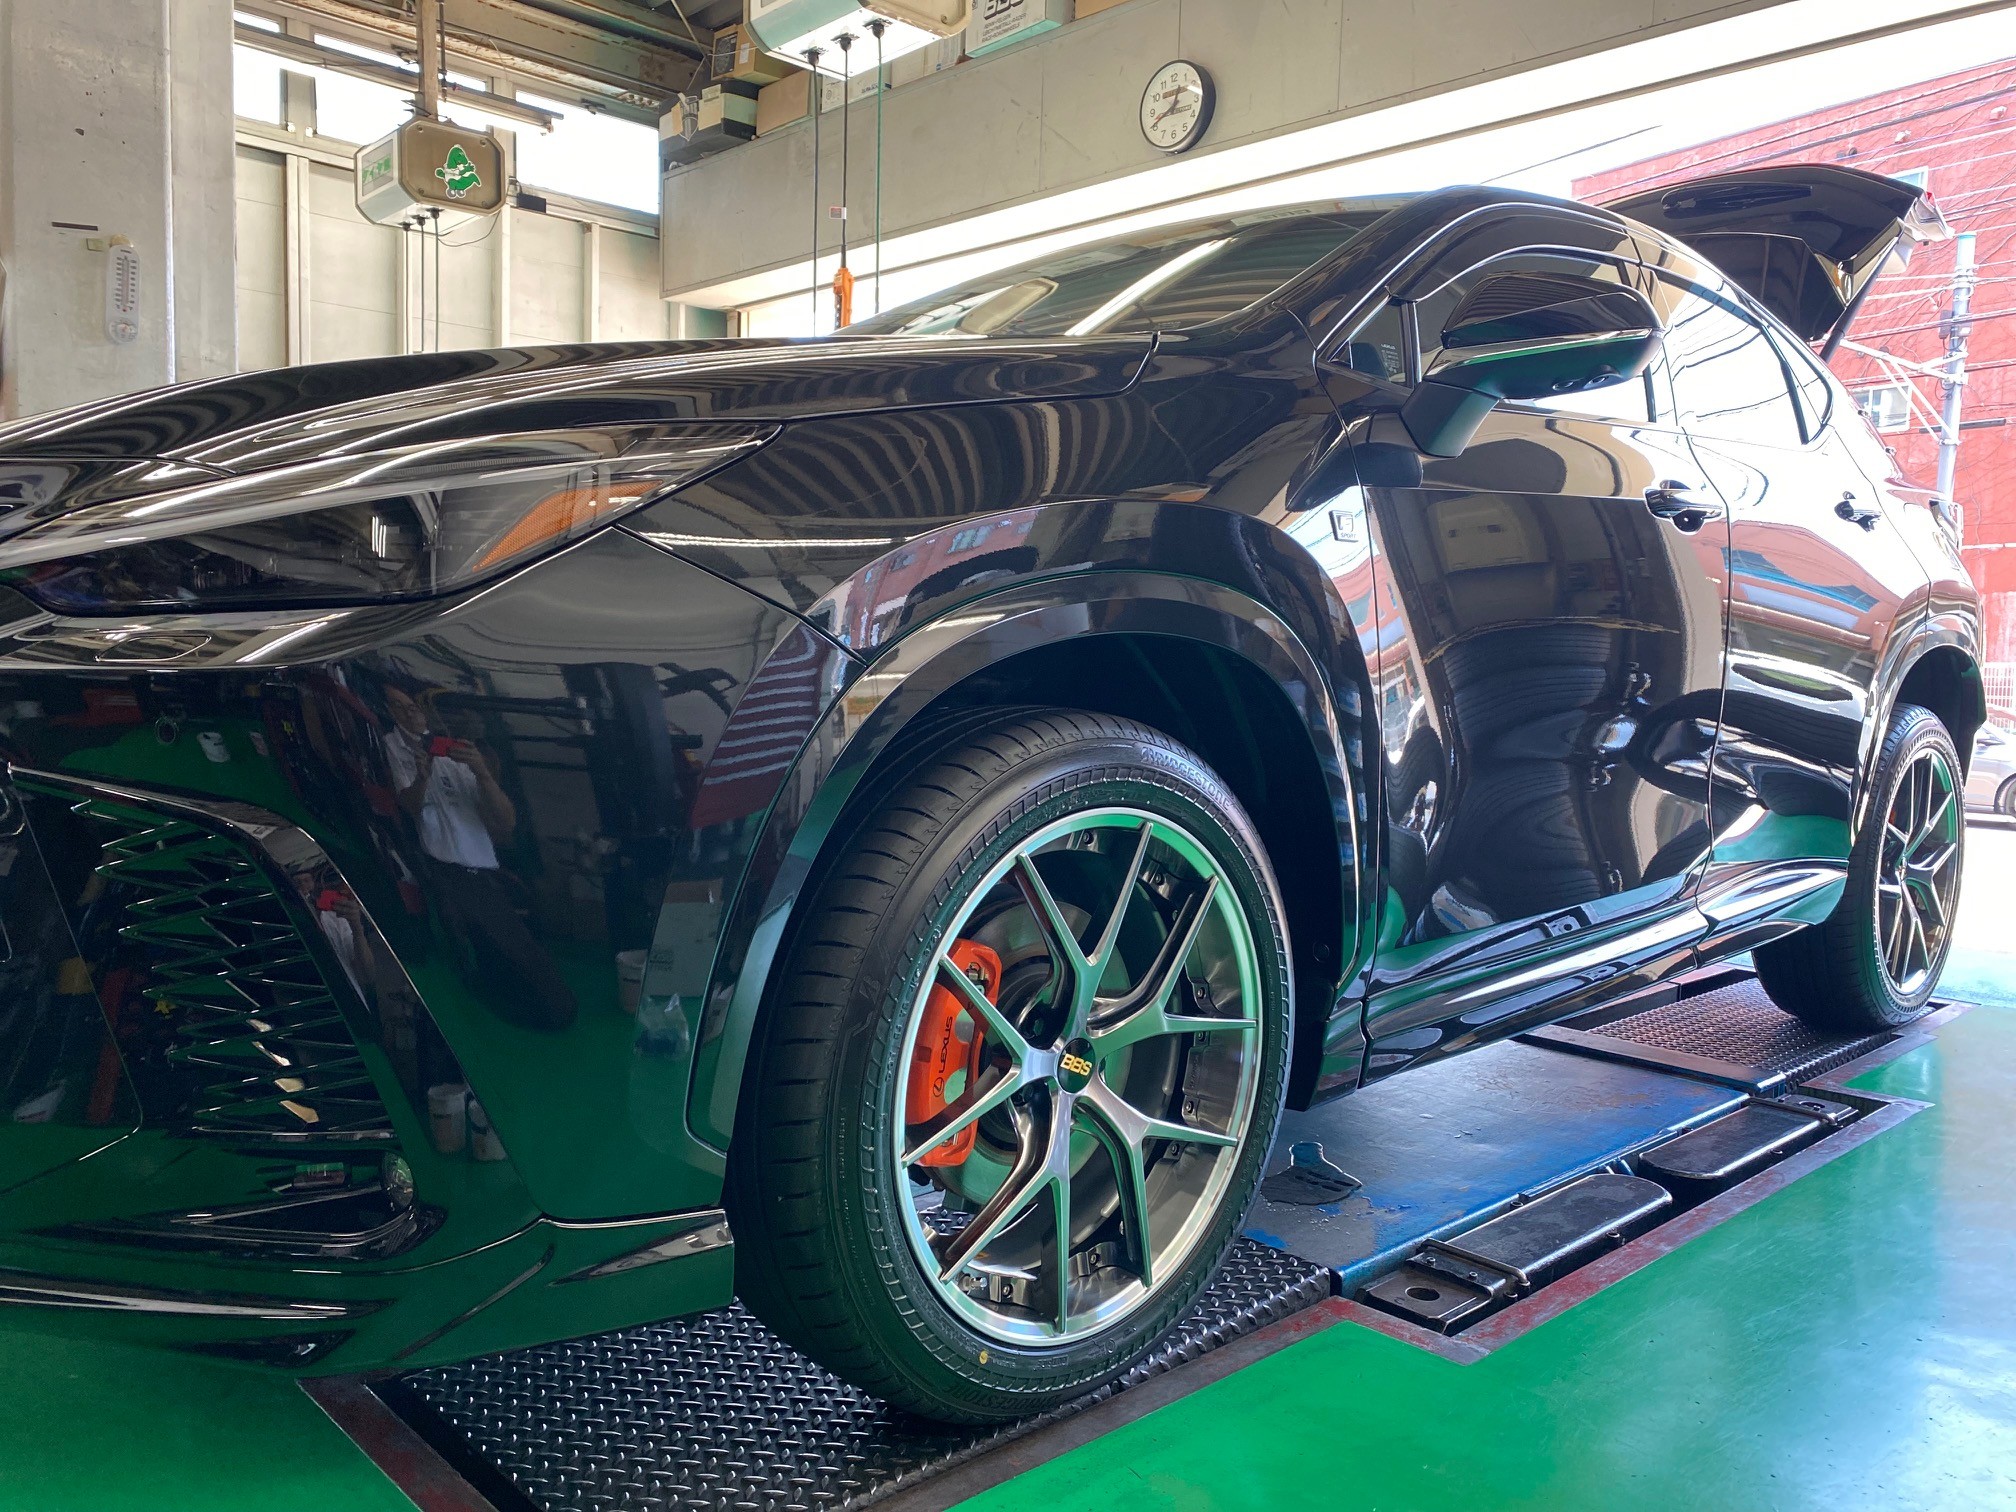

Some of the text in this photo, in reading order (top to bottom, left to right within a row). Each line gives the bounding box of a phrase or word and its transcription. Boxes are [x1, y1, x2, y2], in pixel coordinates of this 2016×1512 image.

[1170, 72, 1178, 83] 12
[1160, 80, 1167, 90] 11
[1152, 92, 1160, 102] 10
[1193, 94, 1199, 103] 3
[1149, 108, 1155, 118] 9
[1189, 109, 1196, 119] 4
[1182, 122, 1188, 132] 5
[1160, 129, 1167, 139] 7
[1170, 129, 1177, 139] 6
[1140, 747, 1231, 811] BRIDGESTONE
[939, 1016, 953, 1074] LEXUS
[1060, 1053, 1092, 1076] BBS
